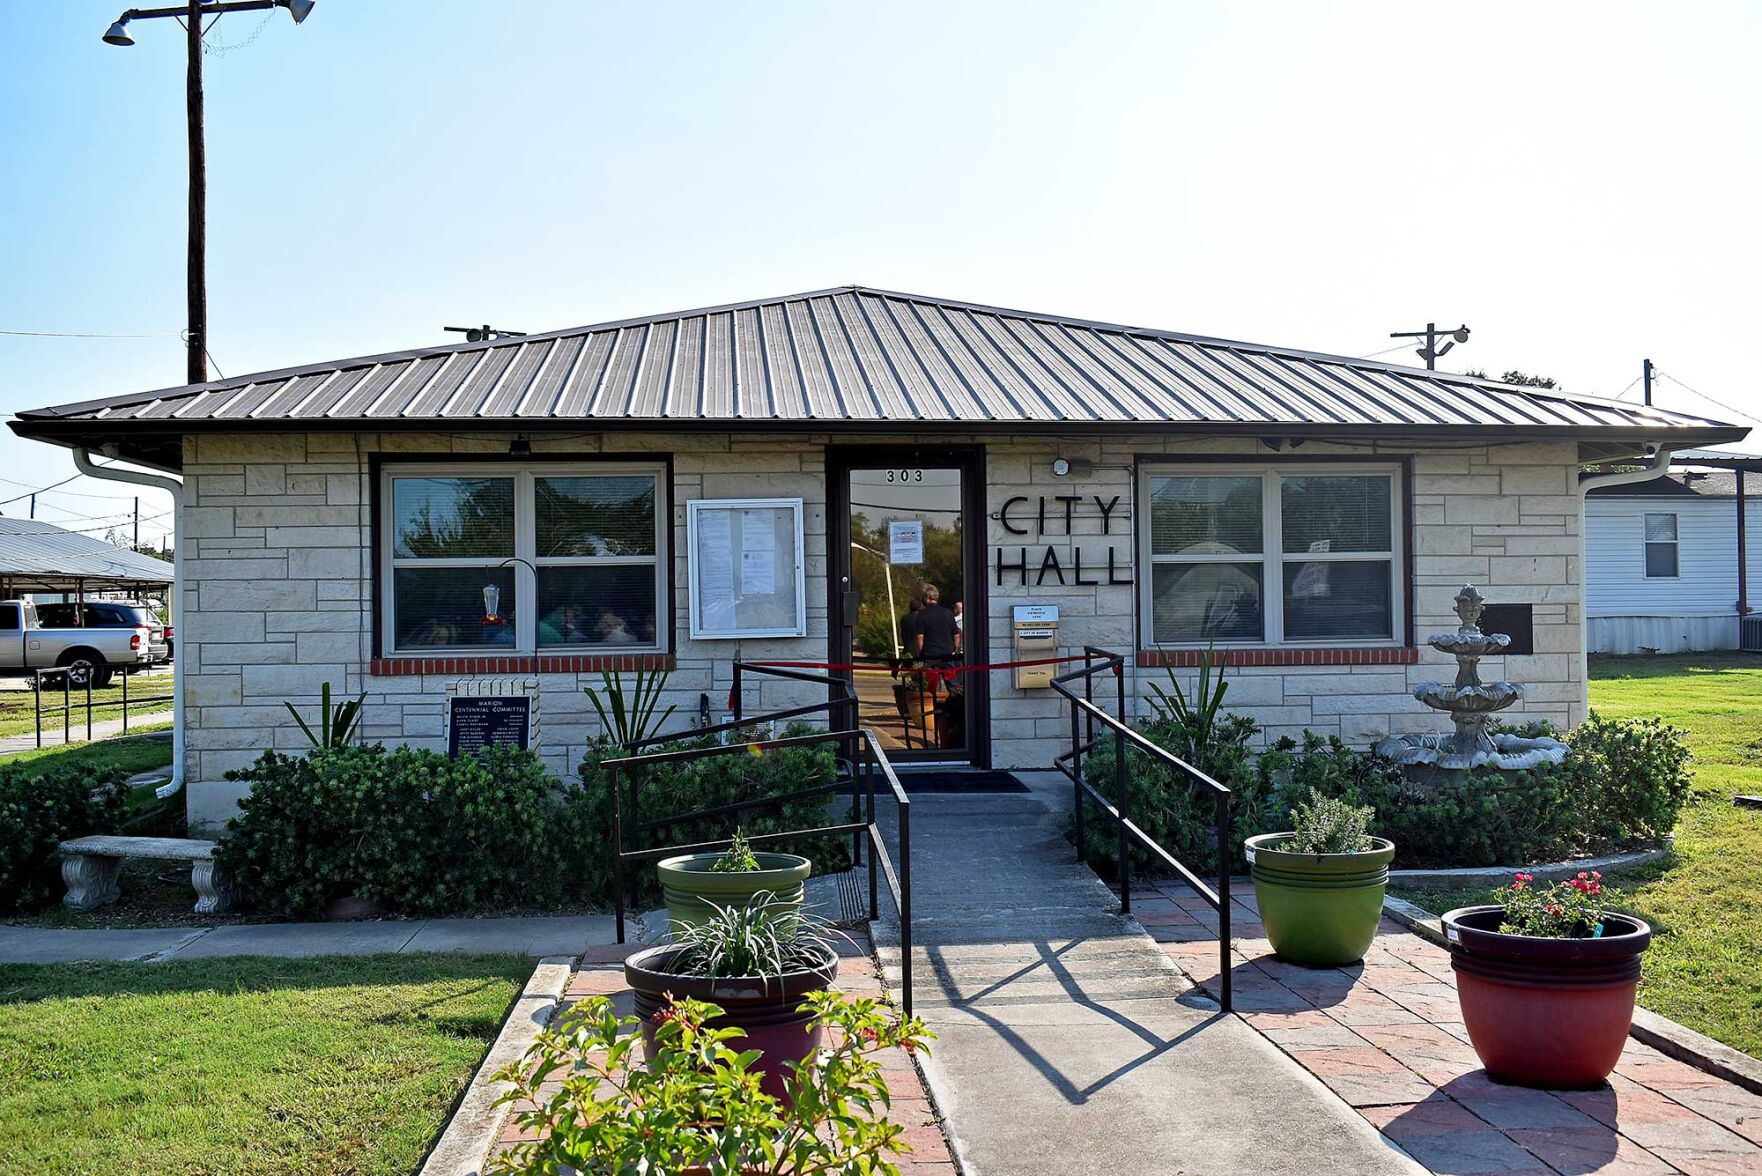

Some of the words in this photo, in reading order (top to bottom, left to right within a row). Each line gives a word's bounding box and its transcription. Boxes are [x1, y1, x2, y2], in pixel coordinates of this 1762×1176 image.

[886, 469, 923, 483] 303
[1000, 495, 1121, 536] CITY
[997, 545, 1135, 586] HALL
